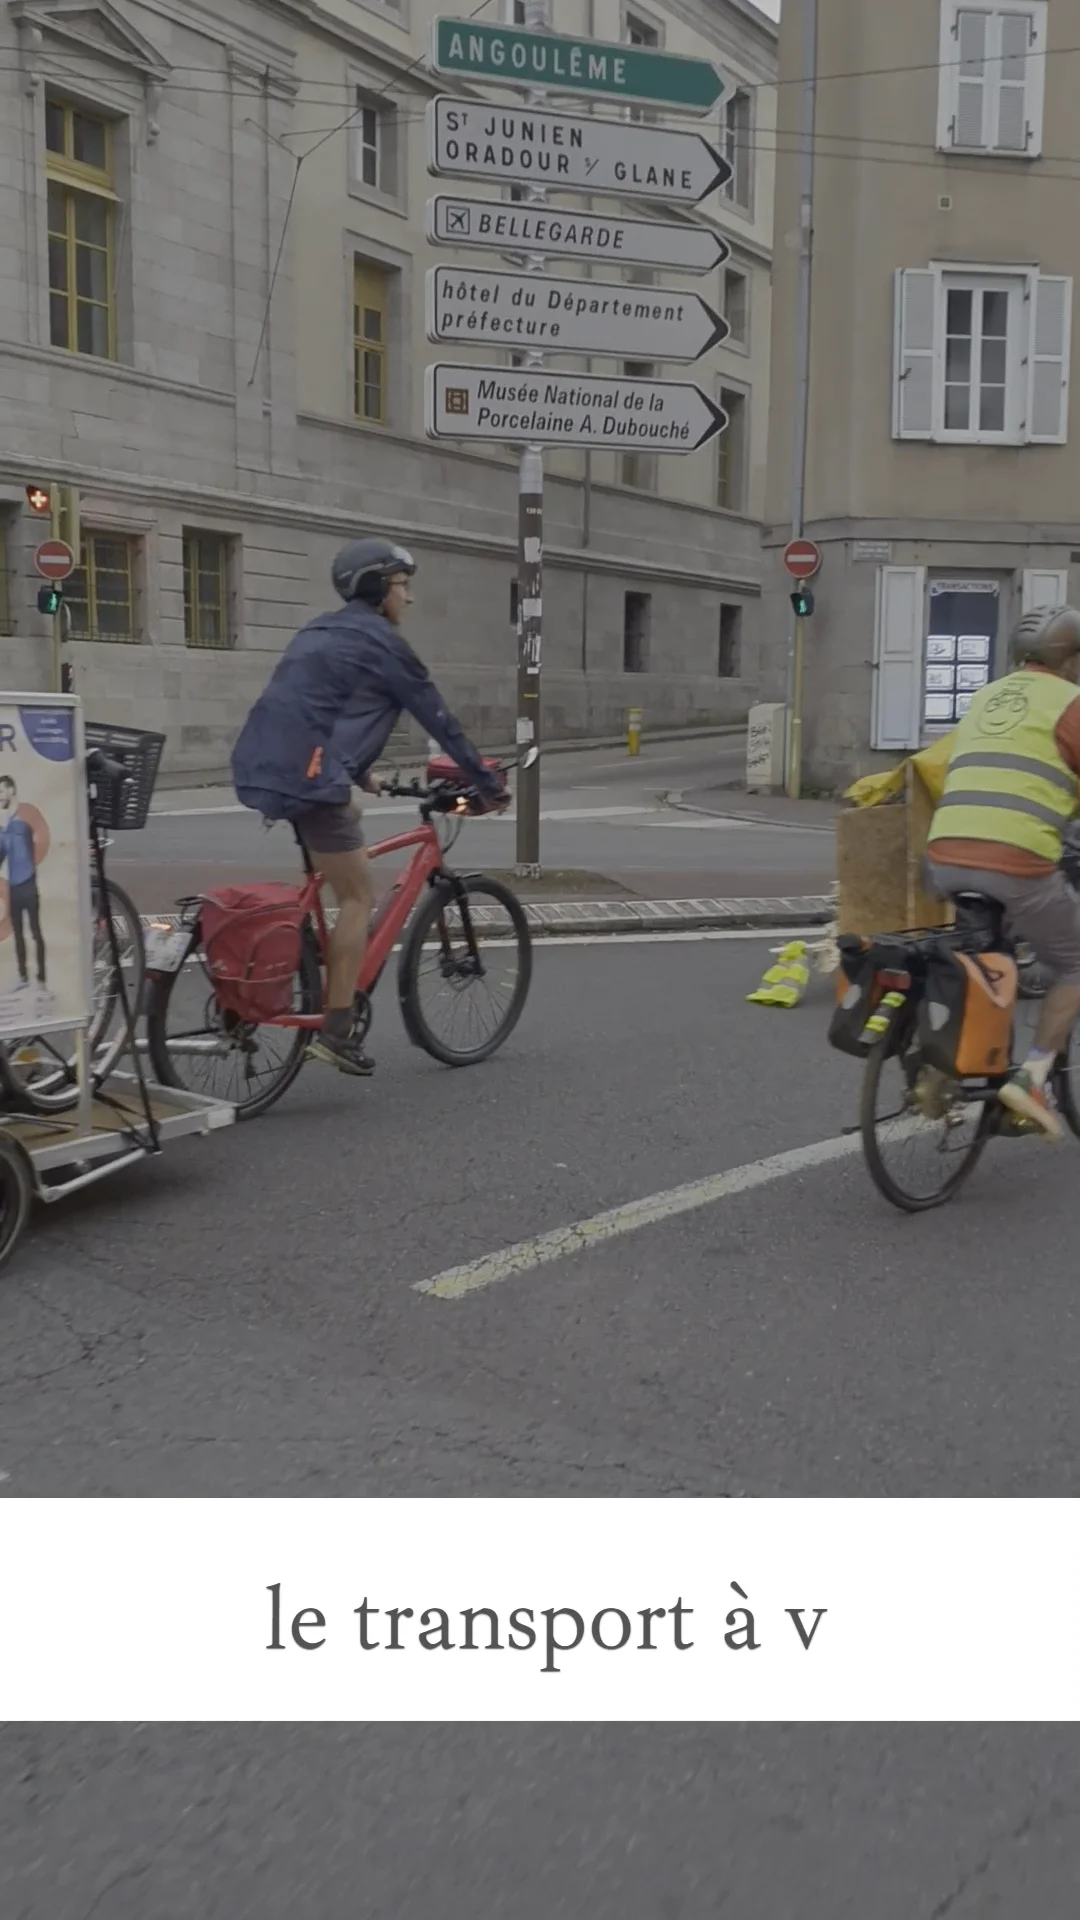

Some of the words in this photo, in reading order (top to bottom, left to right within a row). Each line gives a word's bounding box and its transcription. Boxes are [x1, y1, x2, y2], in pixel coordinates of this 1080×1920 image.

[449, 32, 627, 84] ANGOULÊME
[485, 116, 583, 148] JUNIEN
[446, 140, 570, 173] ORADOUR
[614, 162, 692, 189] GLANE
[479, 213, 624, 249] BELLEGARDE
[442, 280, 499, 304] hôtel
[512, 288, 535, 307] du
[548, 290, 684, 321] Département
[441, 312, 561, 336] préfecture
[477, 379, 538, 402] Musée
[544, 385, 618, 409] National
[623, 393, 644, 411] de
[649, 394, 664, 412] la
[477, 407, 573, 433] Porcelaine
[580, 415, 596, 434] A.
[602, 415, 690, 440] Dubouché
